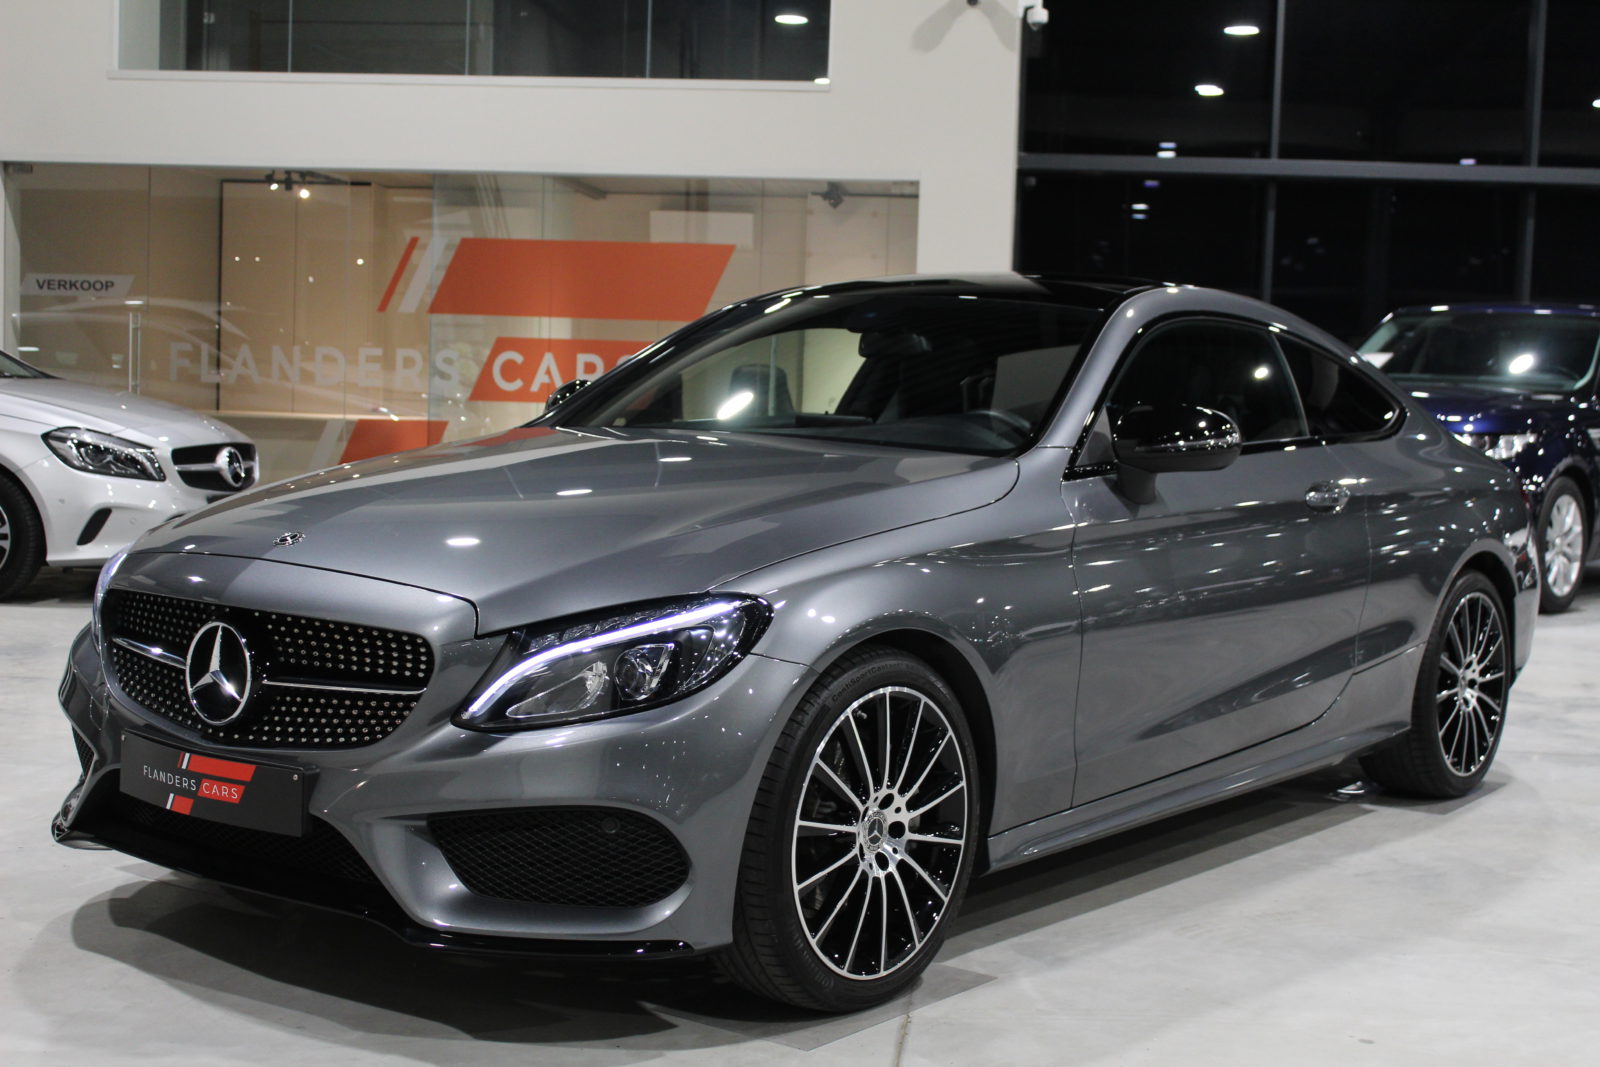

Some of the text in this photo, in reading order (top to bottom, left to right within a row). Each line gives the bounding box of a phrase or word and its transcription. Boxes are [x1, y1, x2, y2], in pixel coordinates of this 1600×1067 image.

[36, 279, 115, 292] VERKOOP
[169, 342, 632, 392] FLANDERS CAR
[143, 765, 238, 799] FLANDERS CARS
